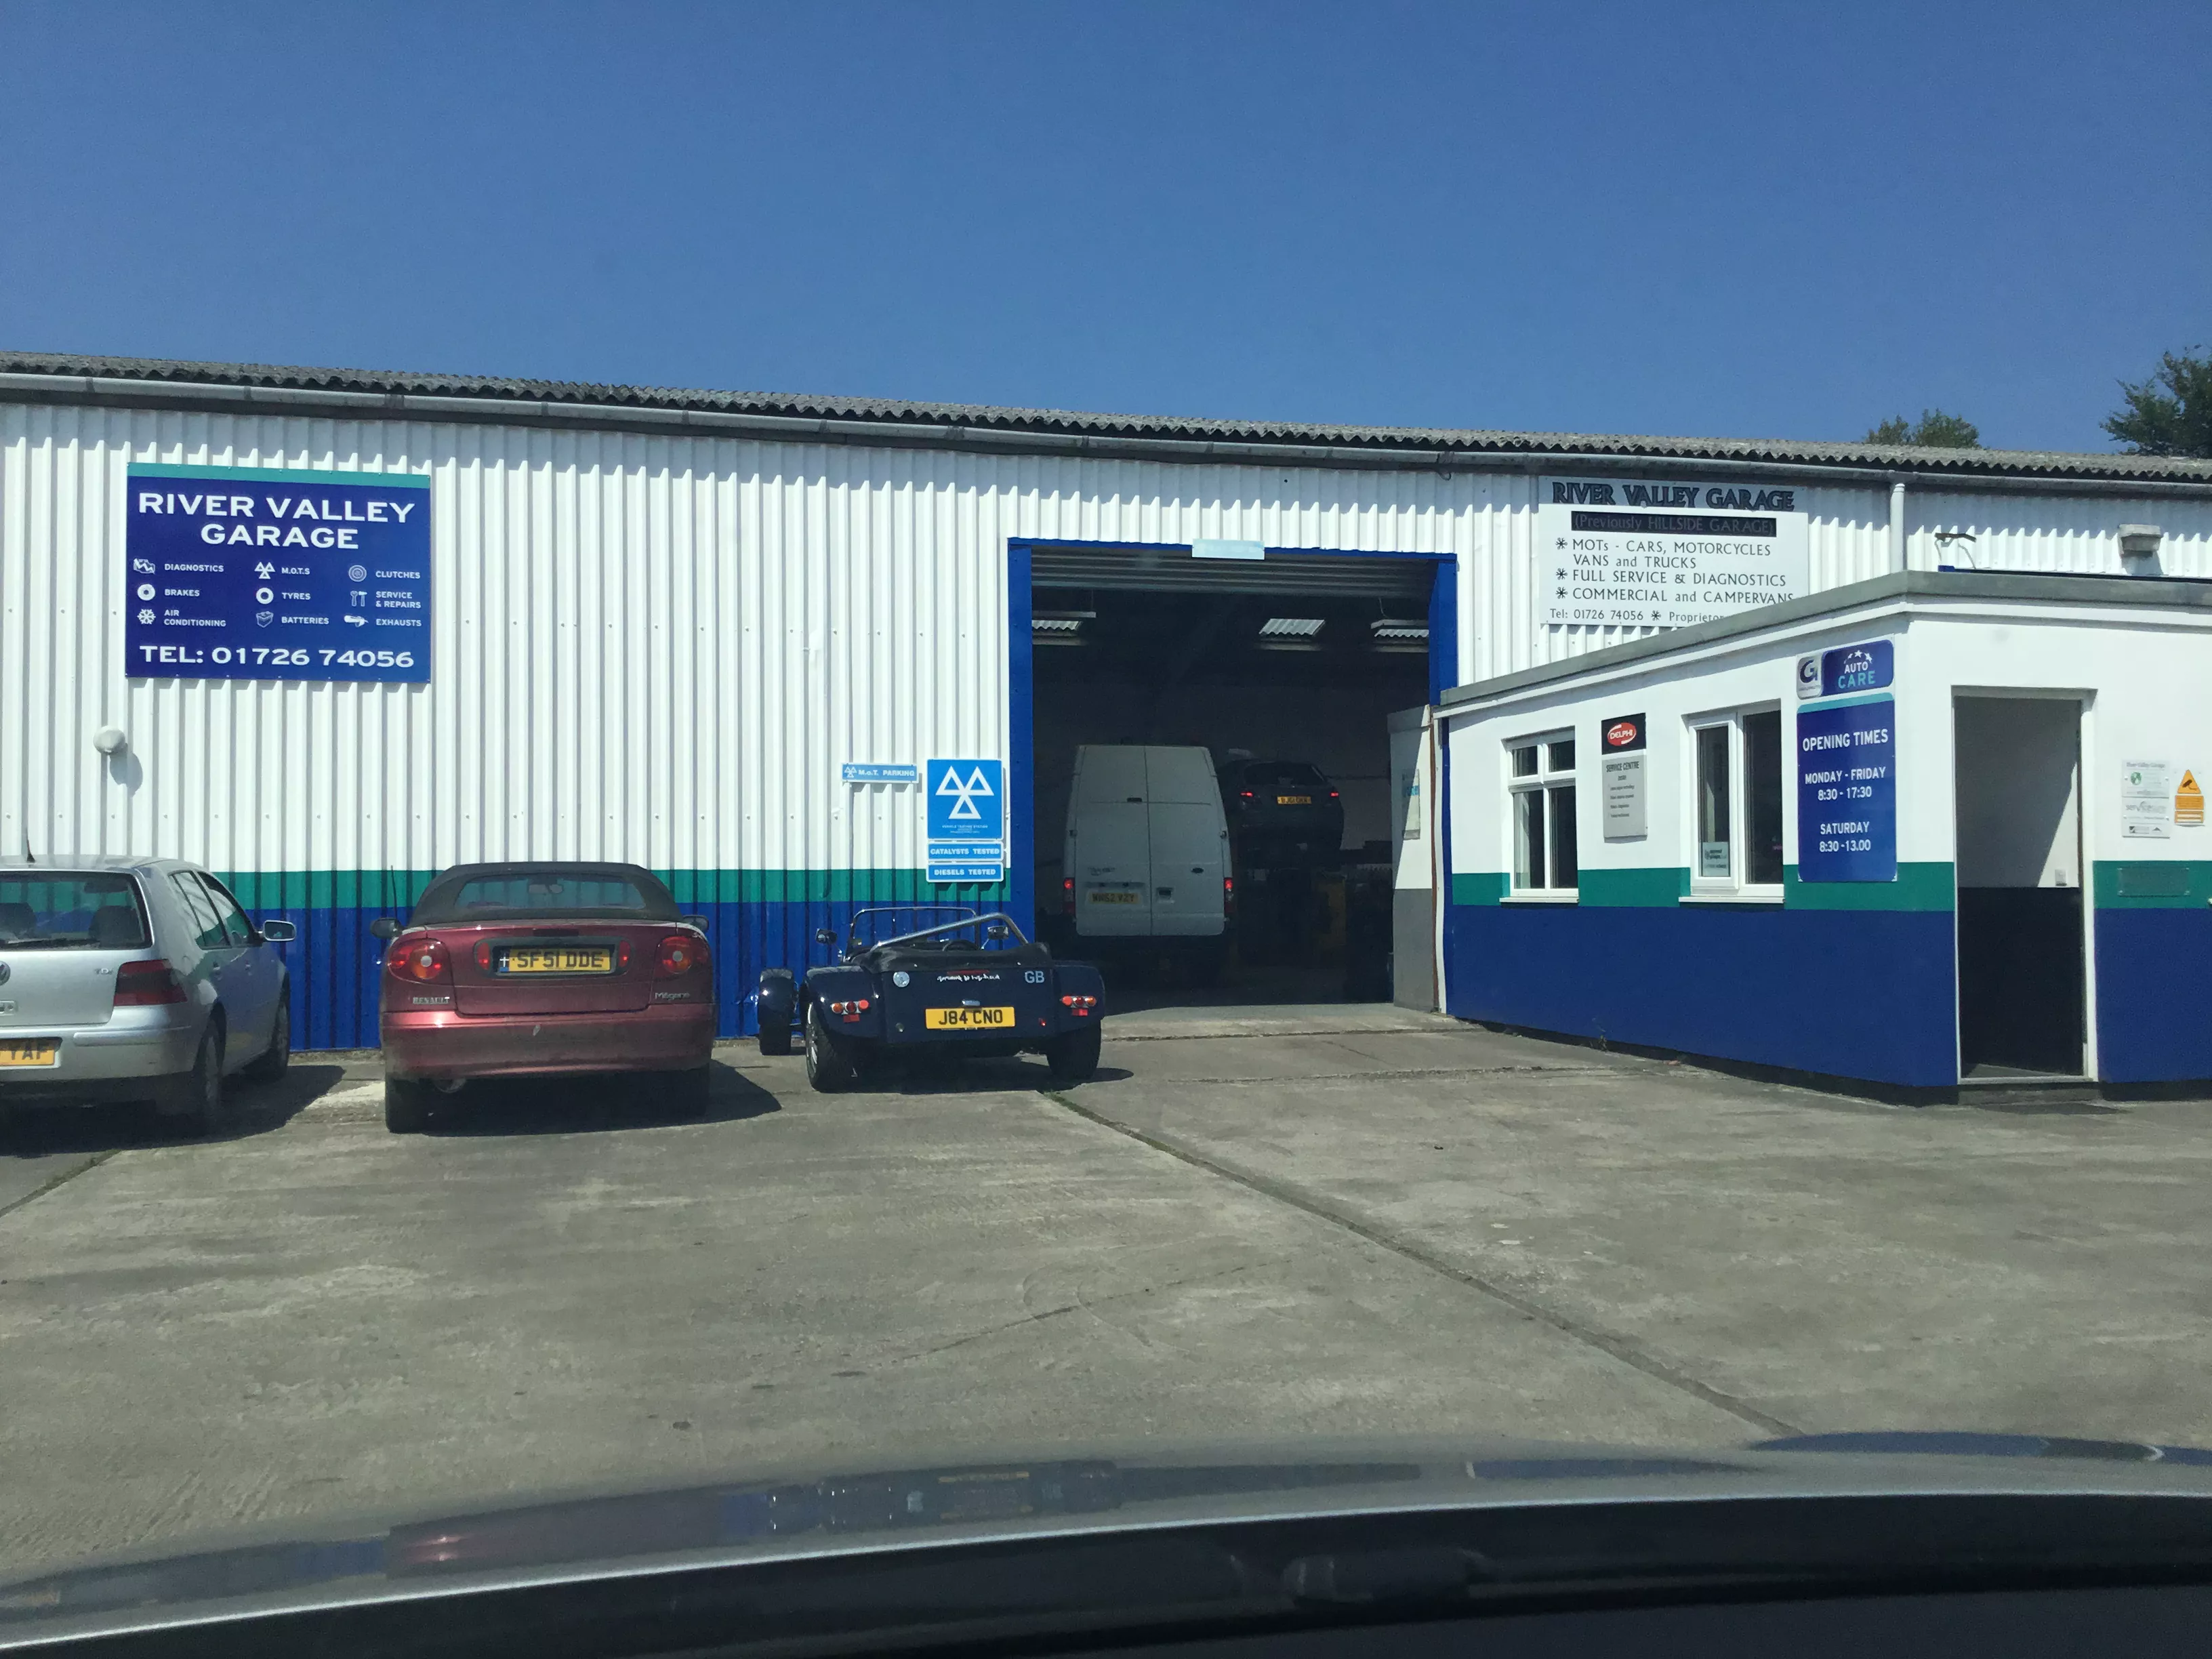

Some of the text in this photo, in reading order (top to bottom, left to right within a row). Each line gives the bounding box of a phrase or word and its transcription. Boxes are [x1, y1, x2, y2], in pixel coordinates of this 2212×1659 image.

[1552, 482, 1795, 512] RIVER VALLEY GARAGE
[138, 493, 415, 523] RIVER VALLEY
[1575, 514, 1774, 535] (Previously HILLSIDE GARAGE)
[201, 523, 359, 550] GARAGE
[1573, 539, 1609, 551] MOTs
[1626, 541, 1666, 554] CARS,
[1675, 542, 1771, 556] MOTORCYCLES
[165, 563, 224, 573] DIAGNOSTICS
[1574, 555, 1696, 569] VANS and TRUCKS
[375, 570, 421, 579] CLUTCHES
[1573, 570, 1786, 586] FULL SERVICE & DIAGNOSTICS
[165, 589, 200, 597] BRAKES
[281, 592, 311, 600] TYRES
[375, 590, 413, 600] SERVICE
[1573, 588, 1668, 601] COMMERCIAL
[1675, 591, 1696, 602] and
[384, 600, 422, 609] REPAIRS
[281, 616, 329, 626] BATTERIES
[1550, 609, 1568, 619] Tel:
[1574, 609, 1604, 620] 01726
[1611, 609, 1643, 621] 74056
[164, 619, 226, 628] CONDITIONING
[375, 618, 422, 627] EXHAUSTS
[139, 645, 415, 668] TEL: 01726 74056
[1845, 661, 1868, 674] AUTO
[1838, 671, 1876, 689] CARE
[1610, 729, 1633, 739] DELPHI
[1803, 729, 1889, 752] OPENING TIMES
[1805, 770, 1843, 784] MONDAY
[1851, 766, 1886, 781] FRIDAY
[1818, 787, 1838, 801] 8:30
[1847, 785, 1872, 799] 17:30
[1820, 821, 1870, 835] SATURDAY
[1819, 840, 1839, 853] 8:30
[566, 951, 602, 967] DDE
[1024, 970, 1044, 983] GB
[939, 1010, 1003, 1025] J84 CNO
